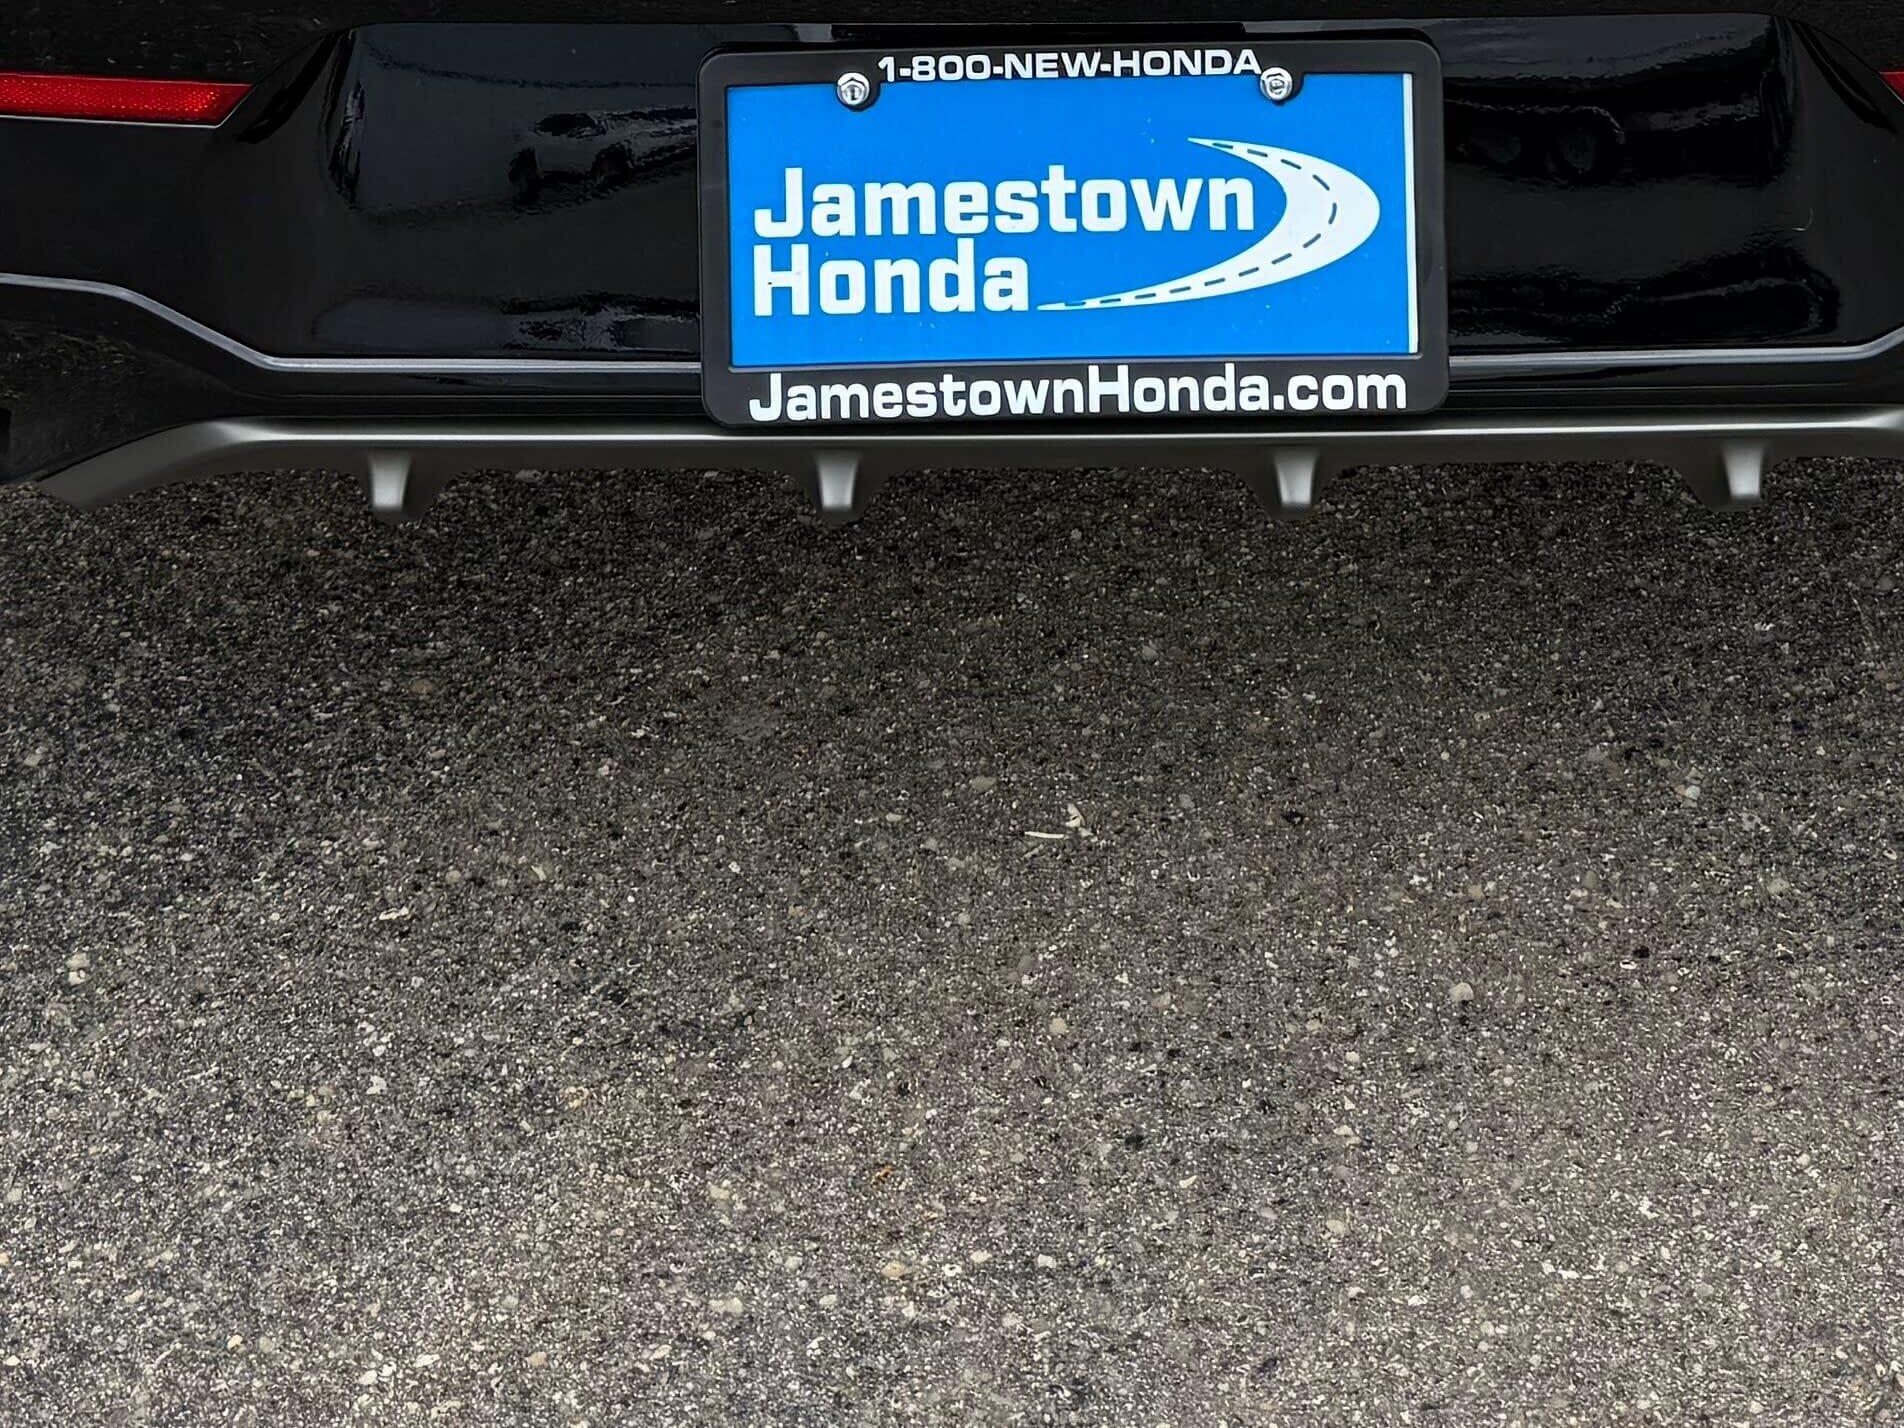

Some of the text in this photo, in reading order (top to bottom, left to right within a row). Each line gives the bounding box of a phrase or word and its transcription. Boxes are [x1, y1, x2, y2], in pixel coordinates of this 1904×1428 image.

[878, 48, 1262, 82] 1-800-NEW-HONDA
[753, 165, 1255, 237] Jamestown
[753, 238, 1029, 316] Honda
[748, 363, 1407, 421] JamestownHonda.com
